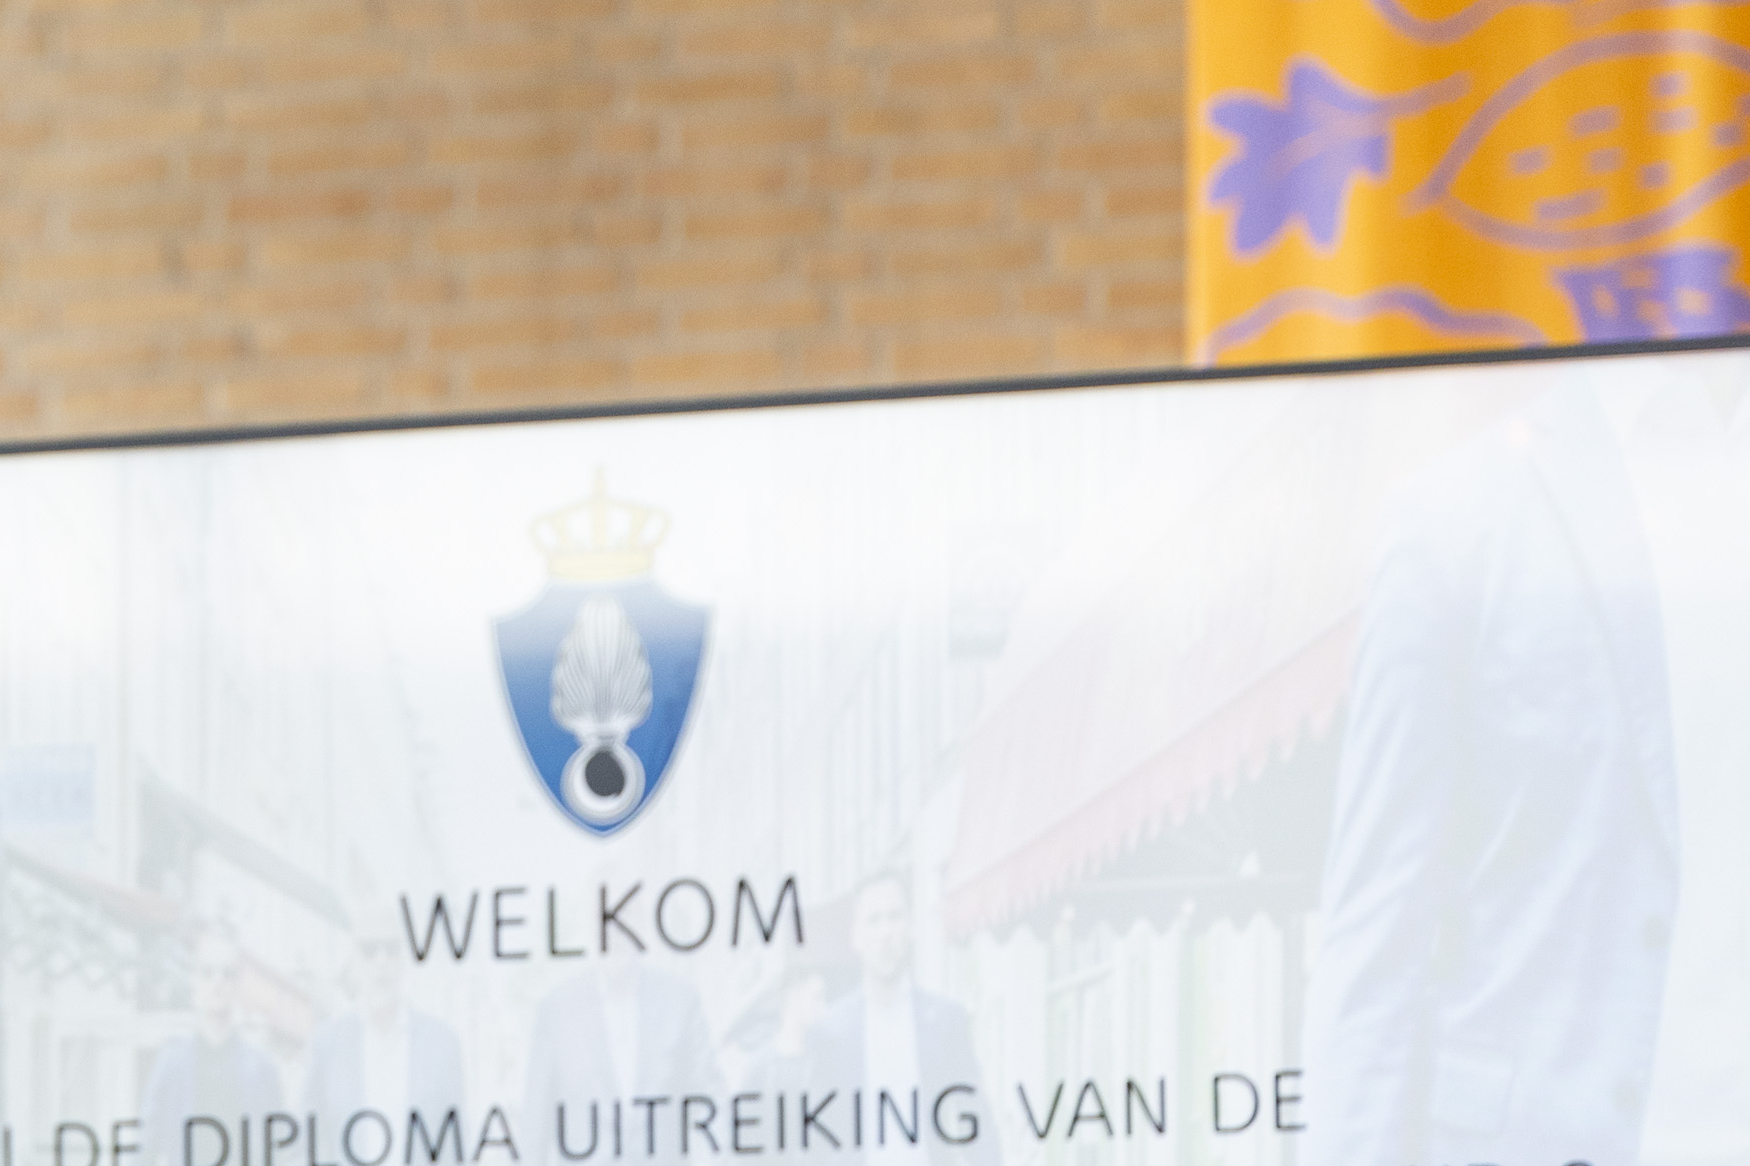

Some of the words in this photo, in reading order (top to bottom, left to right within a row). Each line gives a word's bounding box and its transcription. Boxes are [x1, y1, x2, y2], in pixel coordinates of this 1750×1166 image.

[399, 874, 805, 963] WELKOM
[555, 1083, 979, 1162] UITREIKING
[1017, 1075, 1167, 1140] VAN
[1212, 1067, 1307, 1135] DE
